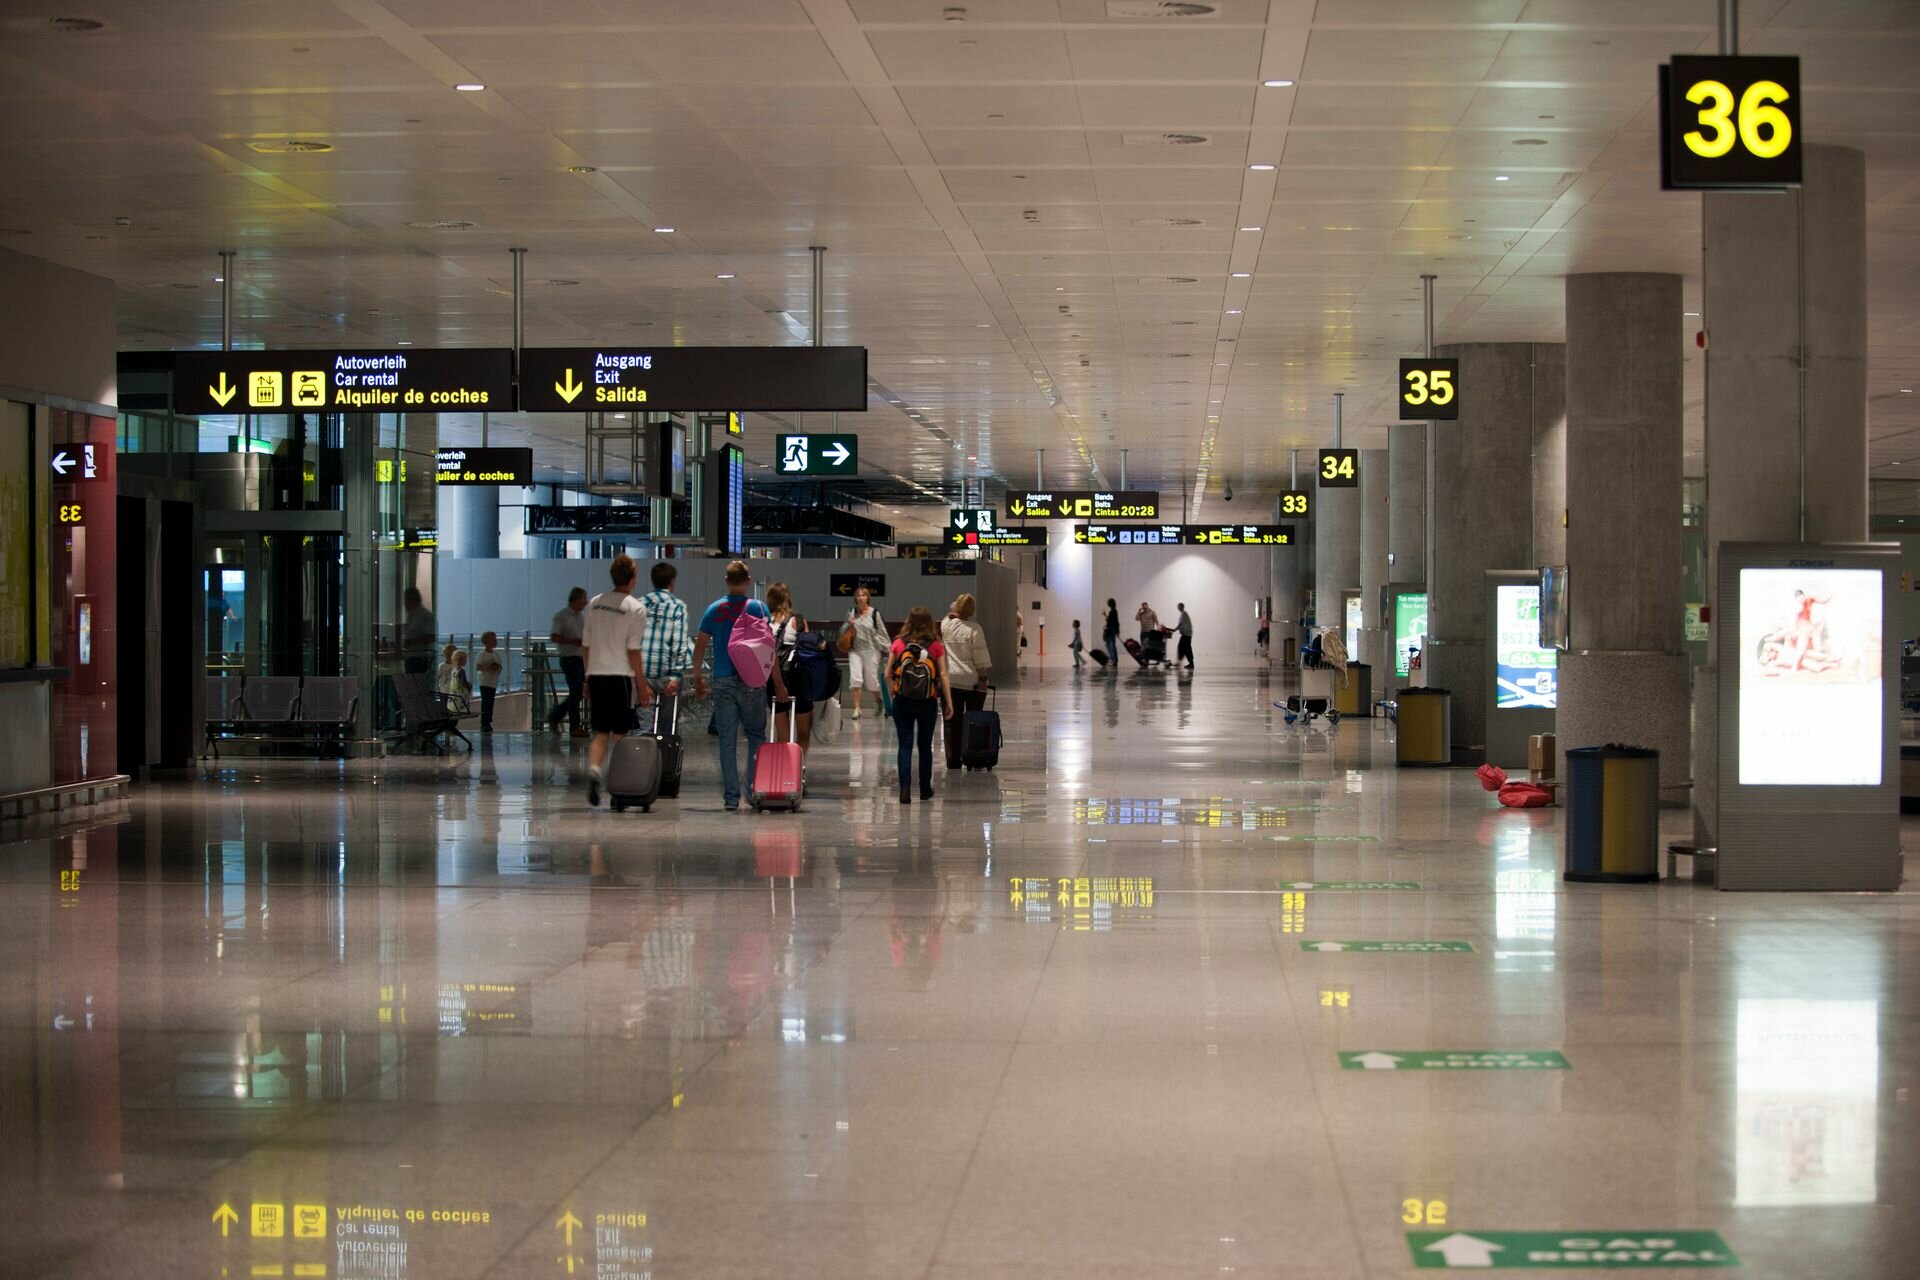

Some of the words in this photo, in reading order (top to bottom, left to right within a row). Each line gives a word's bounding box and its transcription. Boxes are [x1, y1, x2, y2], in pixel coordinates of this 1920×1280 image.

[1683, 80, 1792, 159] 36
[335, 356, 407, 370] Autoverleih
[595, 353, 652, 369] Ausgang
[335, 373, 358, 386] Car
[362, 372, 399, 386] rental
[595, 370, 620, 384] Exit
[595, 387, 647, 402] Salida
[1404, 370, 1454, 405] 35
[335, 389, 399, 408] Alquiler
[404, 388, 425, 404] de
[430, 388, 489, 404] coches
[435, 451, 466, 460] overleih
[438, 461, 461, 470] rental
[1322, 456, 1355, 480] 34
[463, 471, 476, 481] de
[479, 471, 515, 481] coches
[1026, 493, 1052, 501] Ausgang
[1026, 500, 1039, 508] Exit
[1094, 507, 1119, 516] Cintas
[1282, 495, 1307, 514] 33
[1026, 508, 1050, 516] Salida
[1559, 1238, 1677, 1250] CAR
[1527, 1250, 1728, 1262] RENTAL
